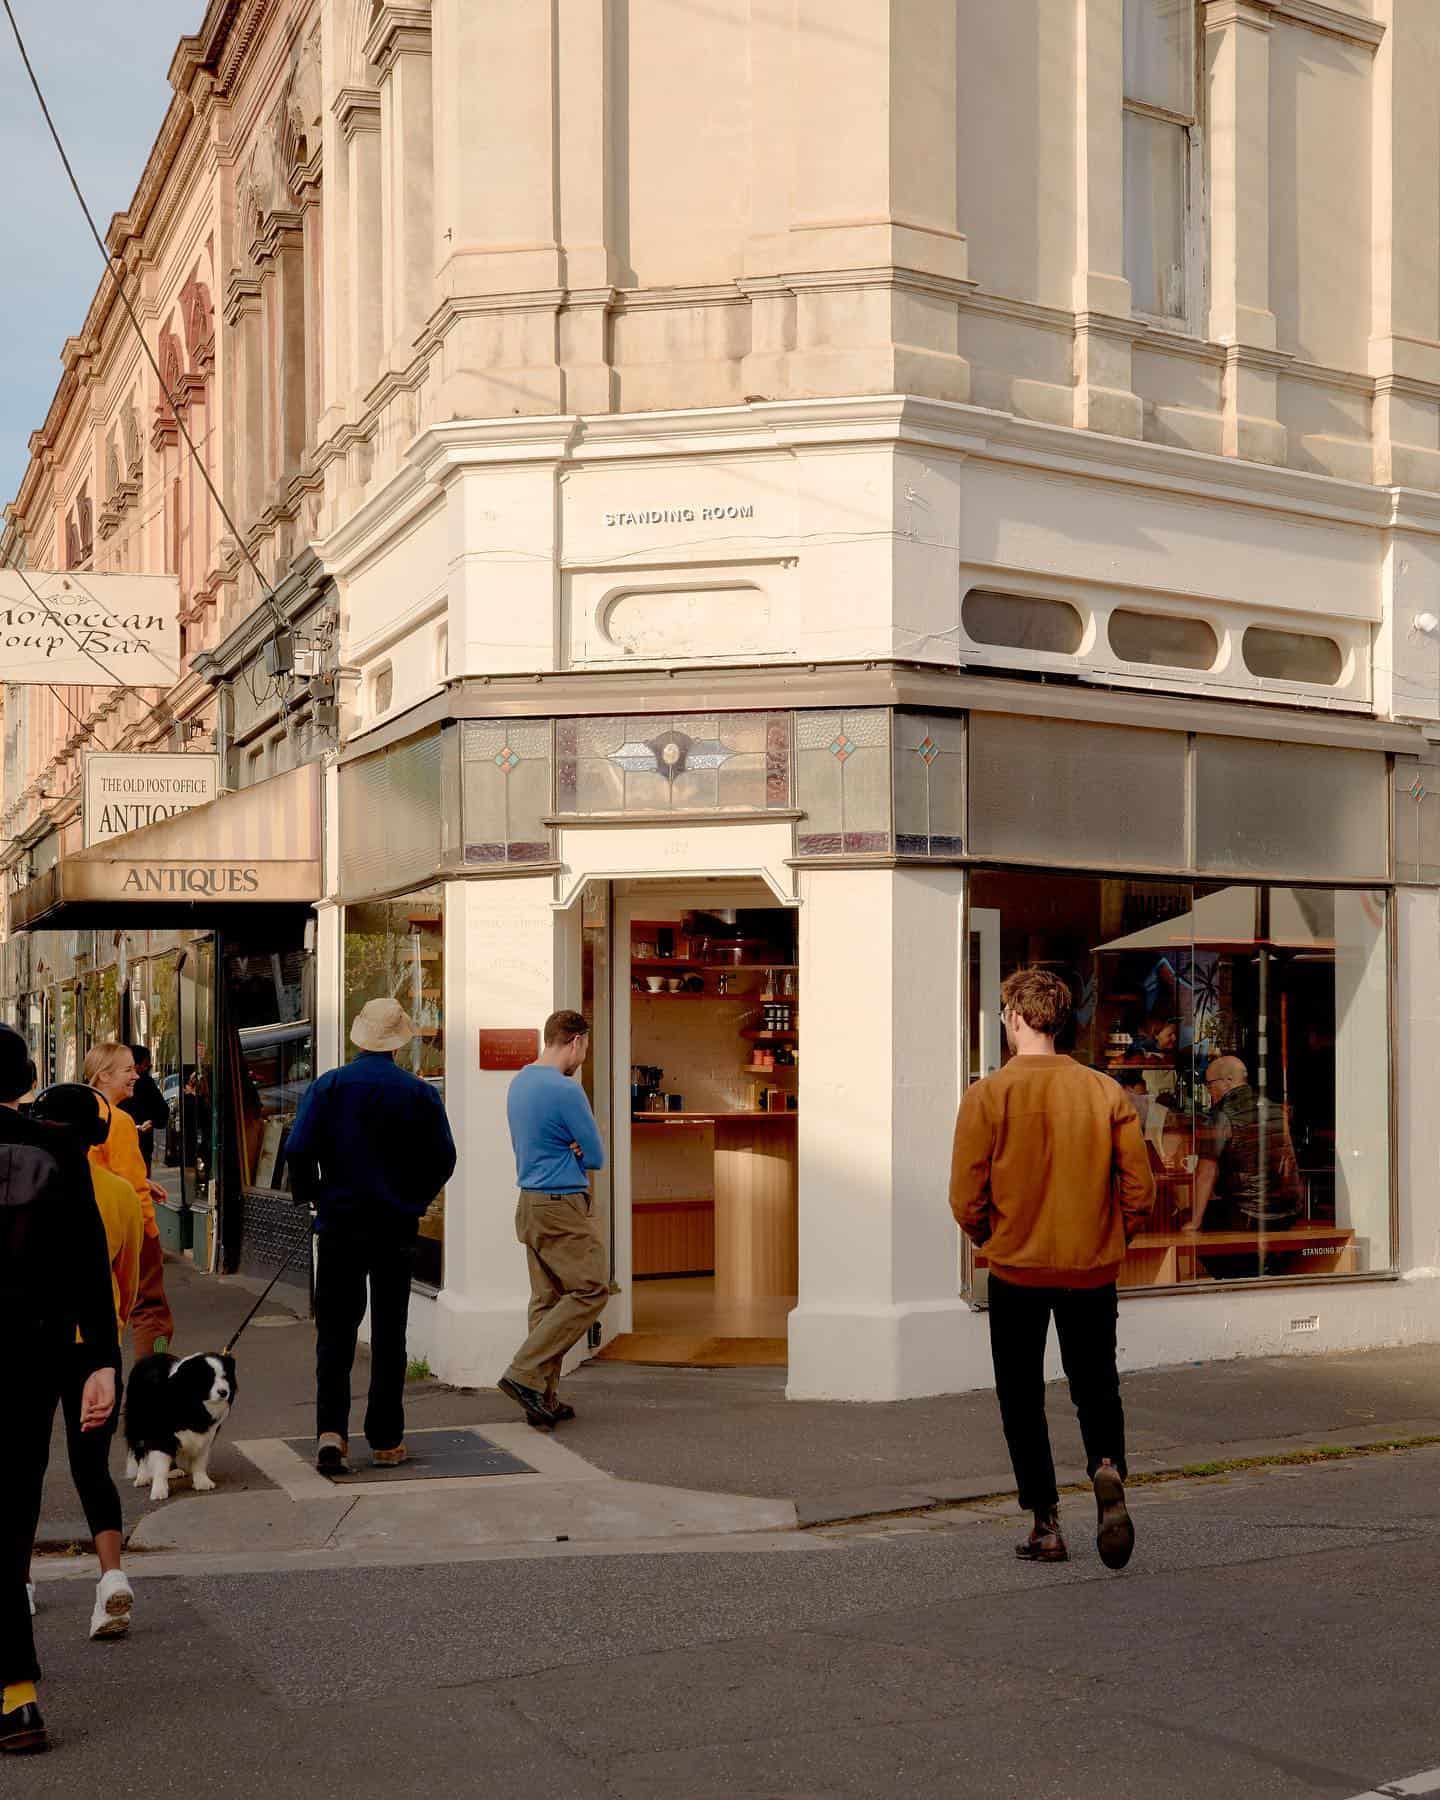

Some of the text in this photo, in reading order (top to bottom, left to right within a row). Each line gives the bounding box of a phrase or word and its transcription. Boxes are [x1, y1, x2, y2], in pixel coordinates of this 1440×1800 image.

[605, 504, 754, 527] STANDING ROOM
[0, 632, 64, 657] oup
[101, 778, 207, 793] THE OLD POST OFFICE
[120, 868, 259, 896] ANTIQUES
